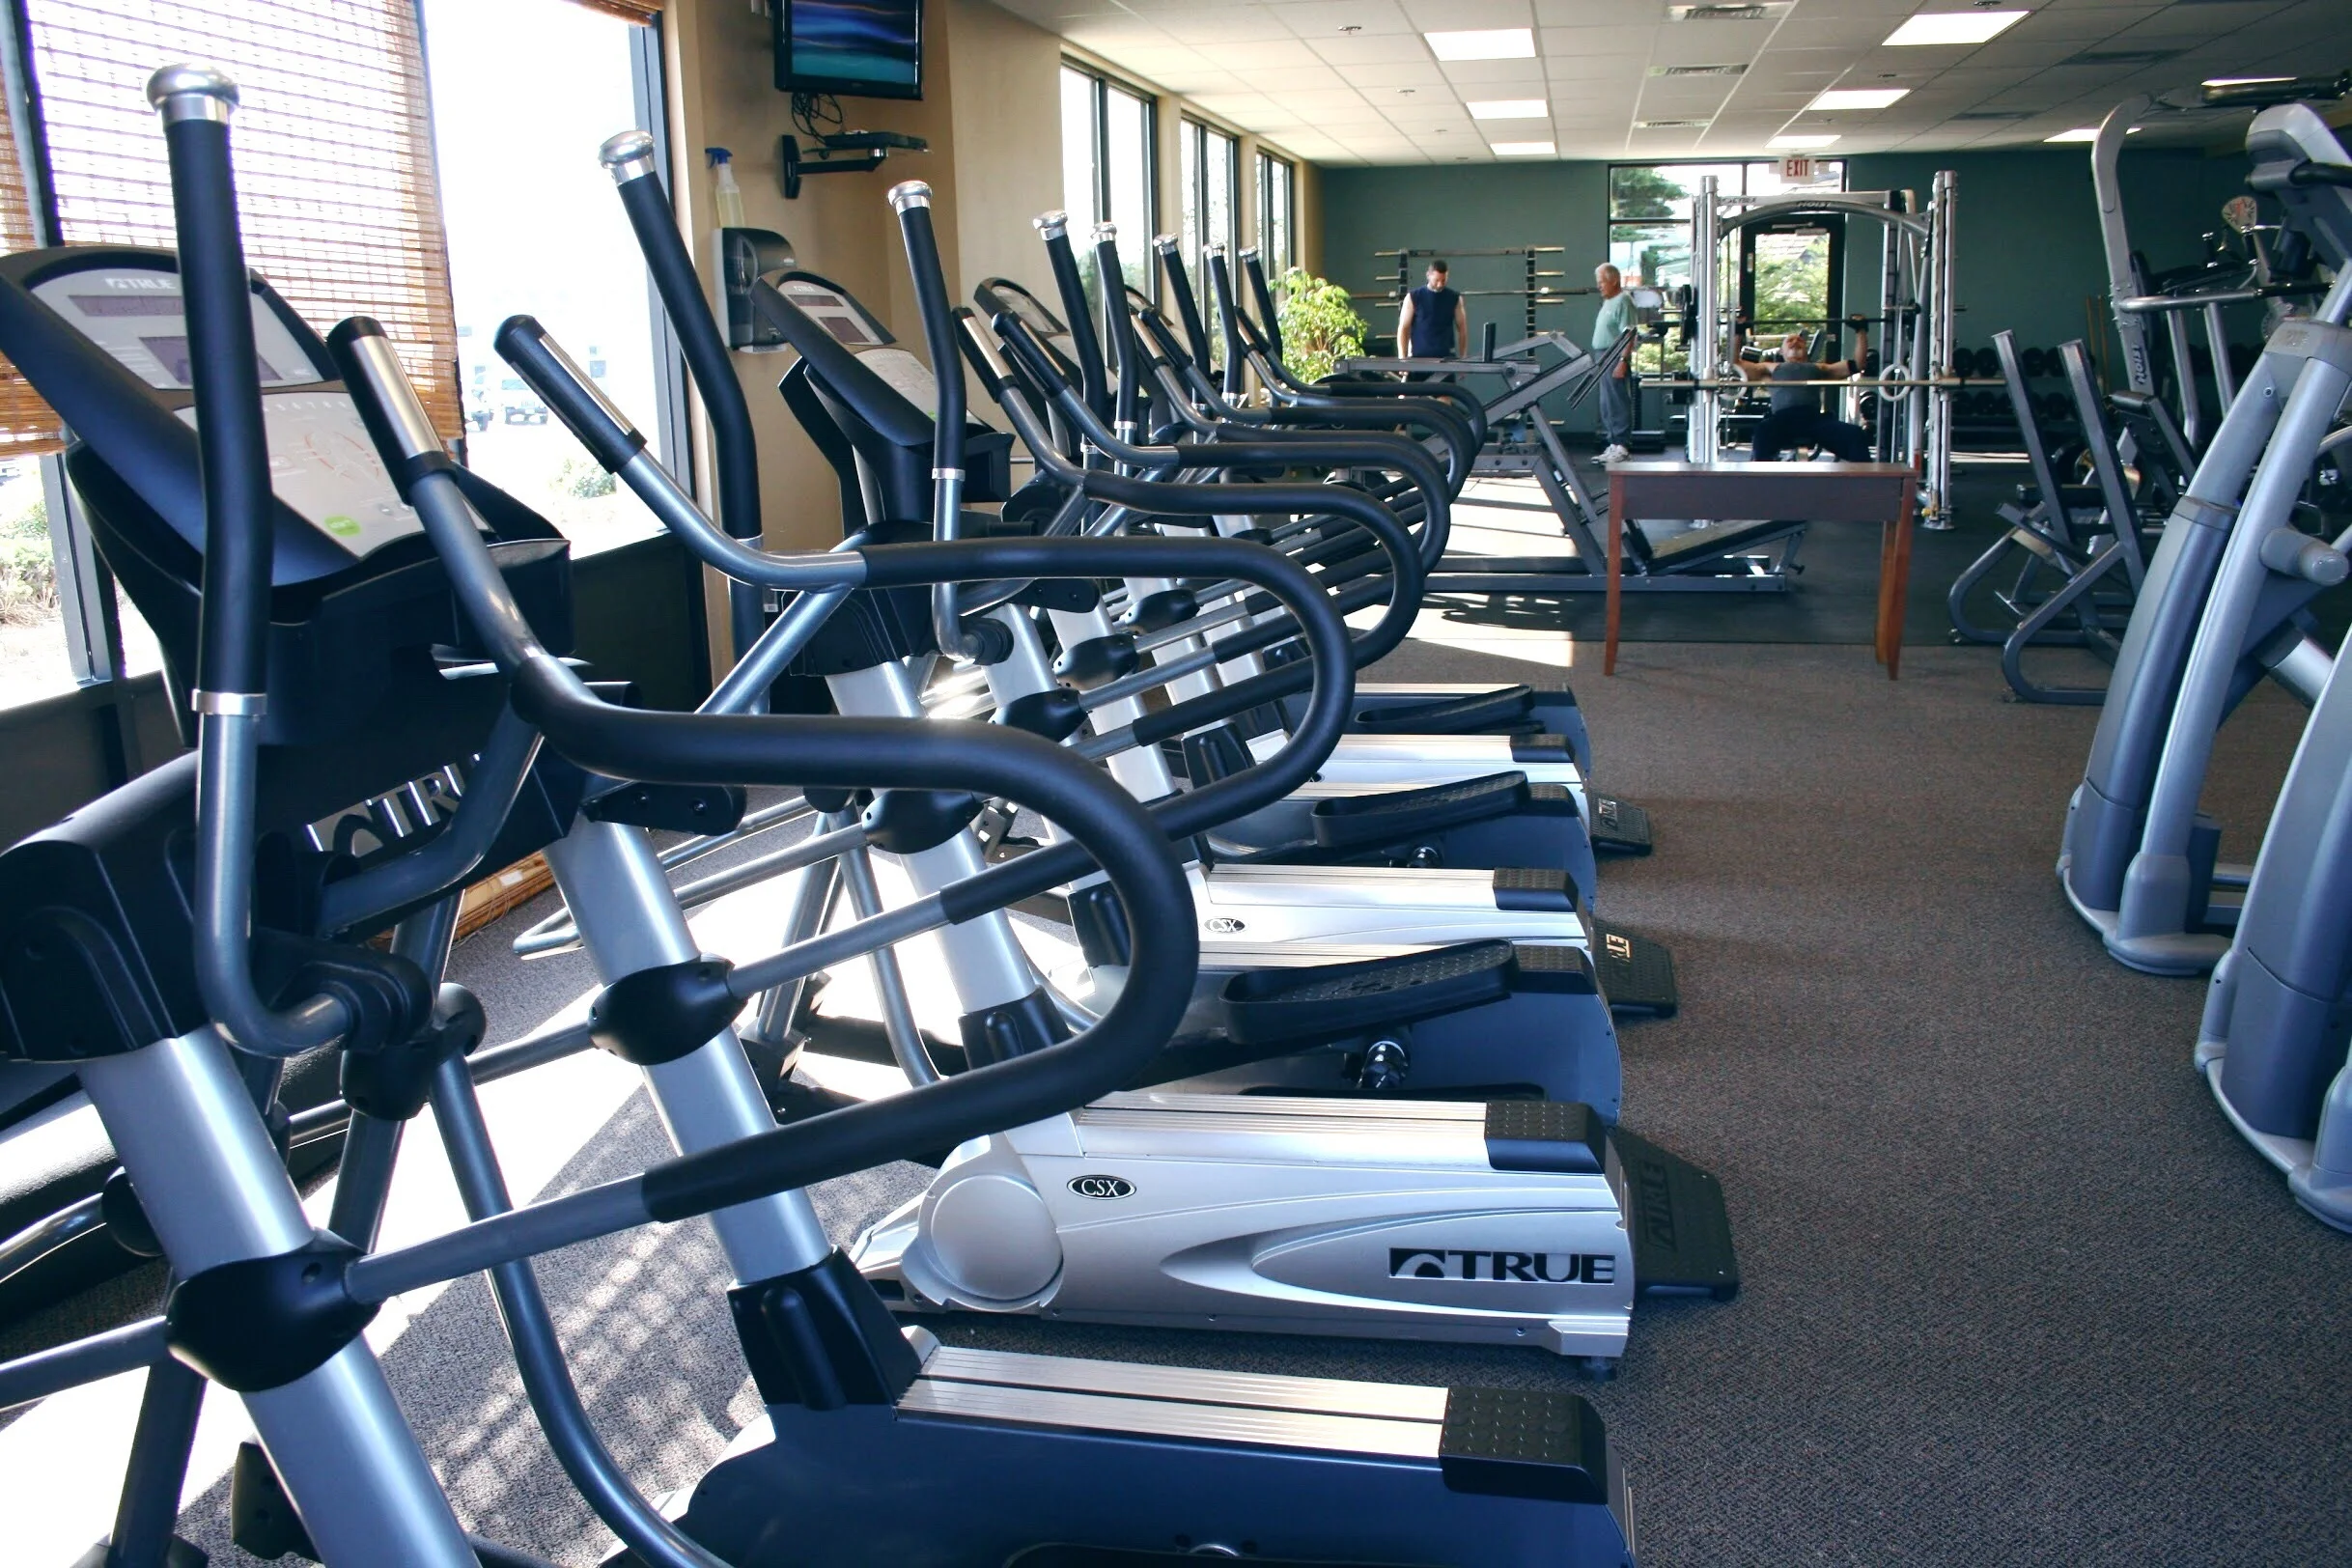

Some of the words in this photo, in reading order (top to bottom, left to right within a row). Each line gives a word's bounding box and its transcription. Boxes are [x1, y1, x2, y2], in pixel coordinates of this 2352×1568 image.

[1786, 158, 1810, 177] EXIT
[126, 277, 176, 290] TRUE
[1080, 1178, 1120, 1196] CSX
[1446, 1249, 1616, 1284] TRUE
